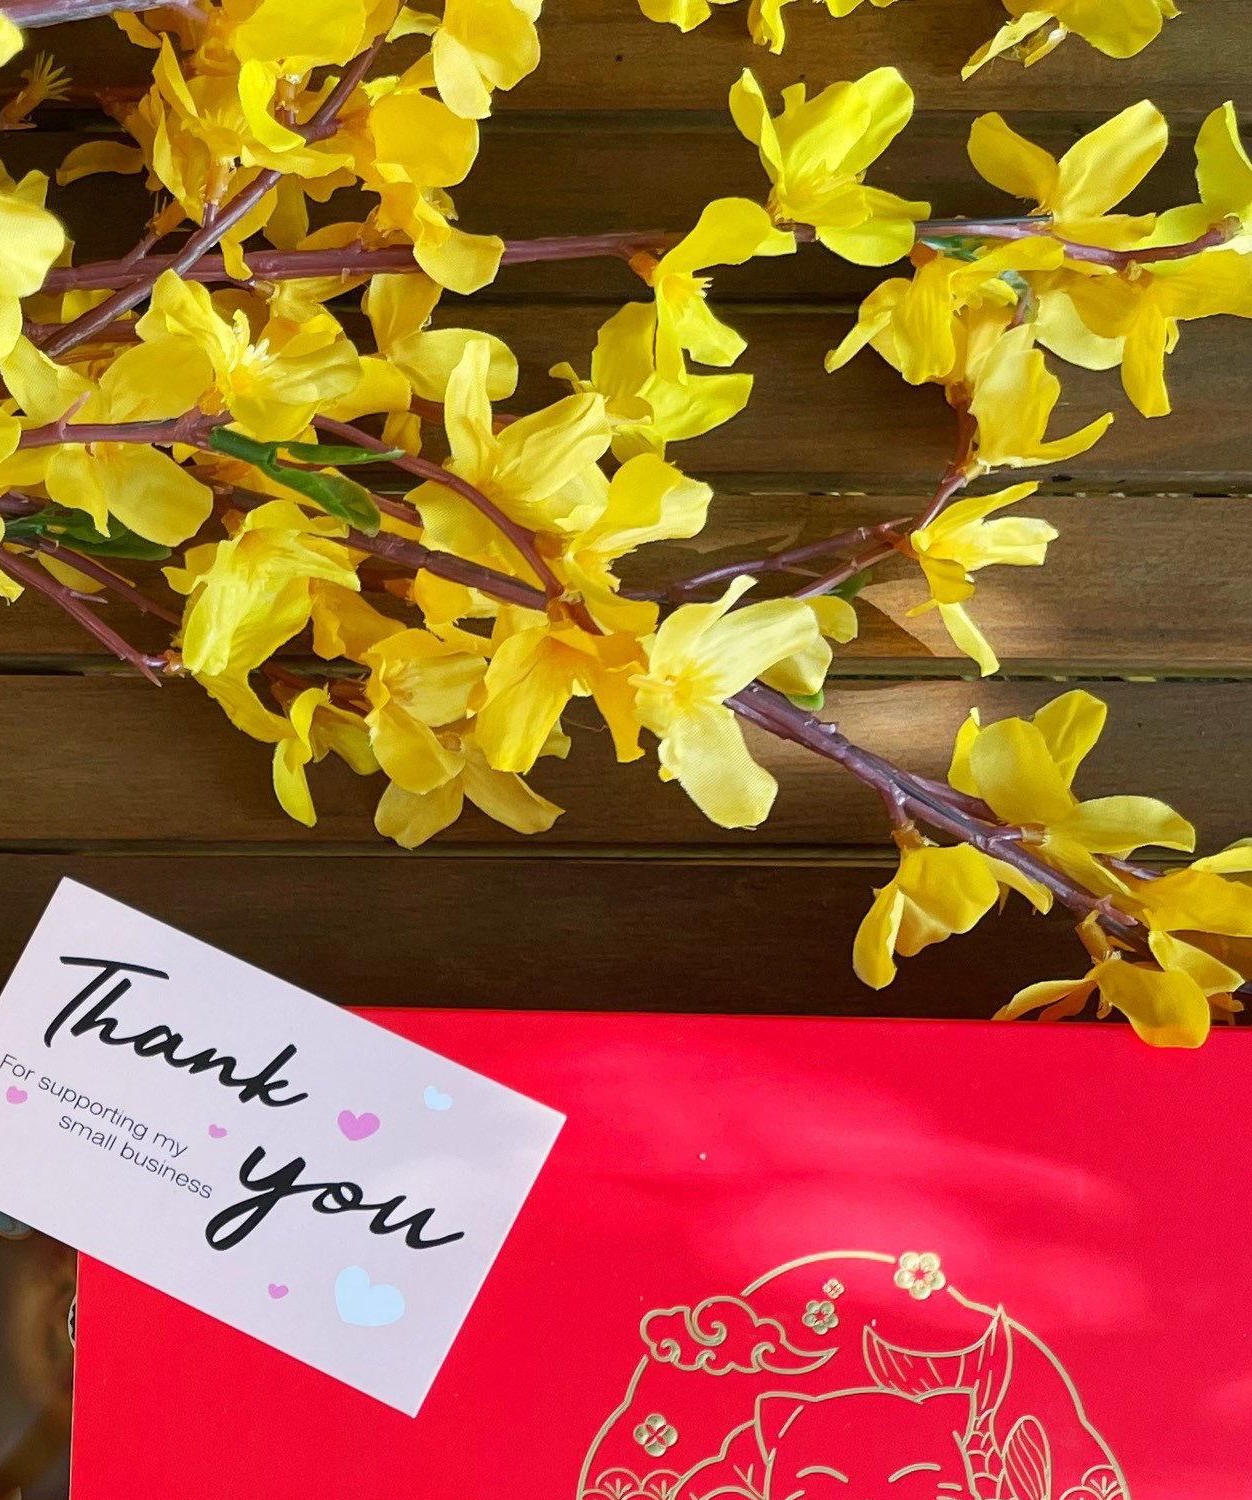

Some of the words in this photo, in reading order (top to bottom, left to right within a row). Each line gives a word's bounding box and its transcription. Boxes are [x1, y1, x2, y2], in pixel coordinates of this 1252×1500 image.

[44, 956, 308, 1107] Thank
[0, 1053, 35, 1081] For
[37, 1076, 148, 1141] supporting
[152, 1132, 188, 1159] my
[58, 1115, 117, 1151] small
[119, 1141, 213, 1199] business
[205, 1146, 464, 1251] you
